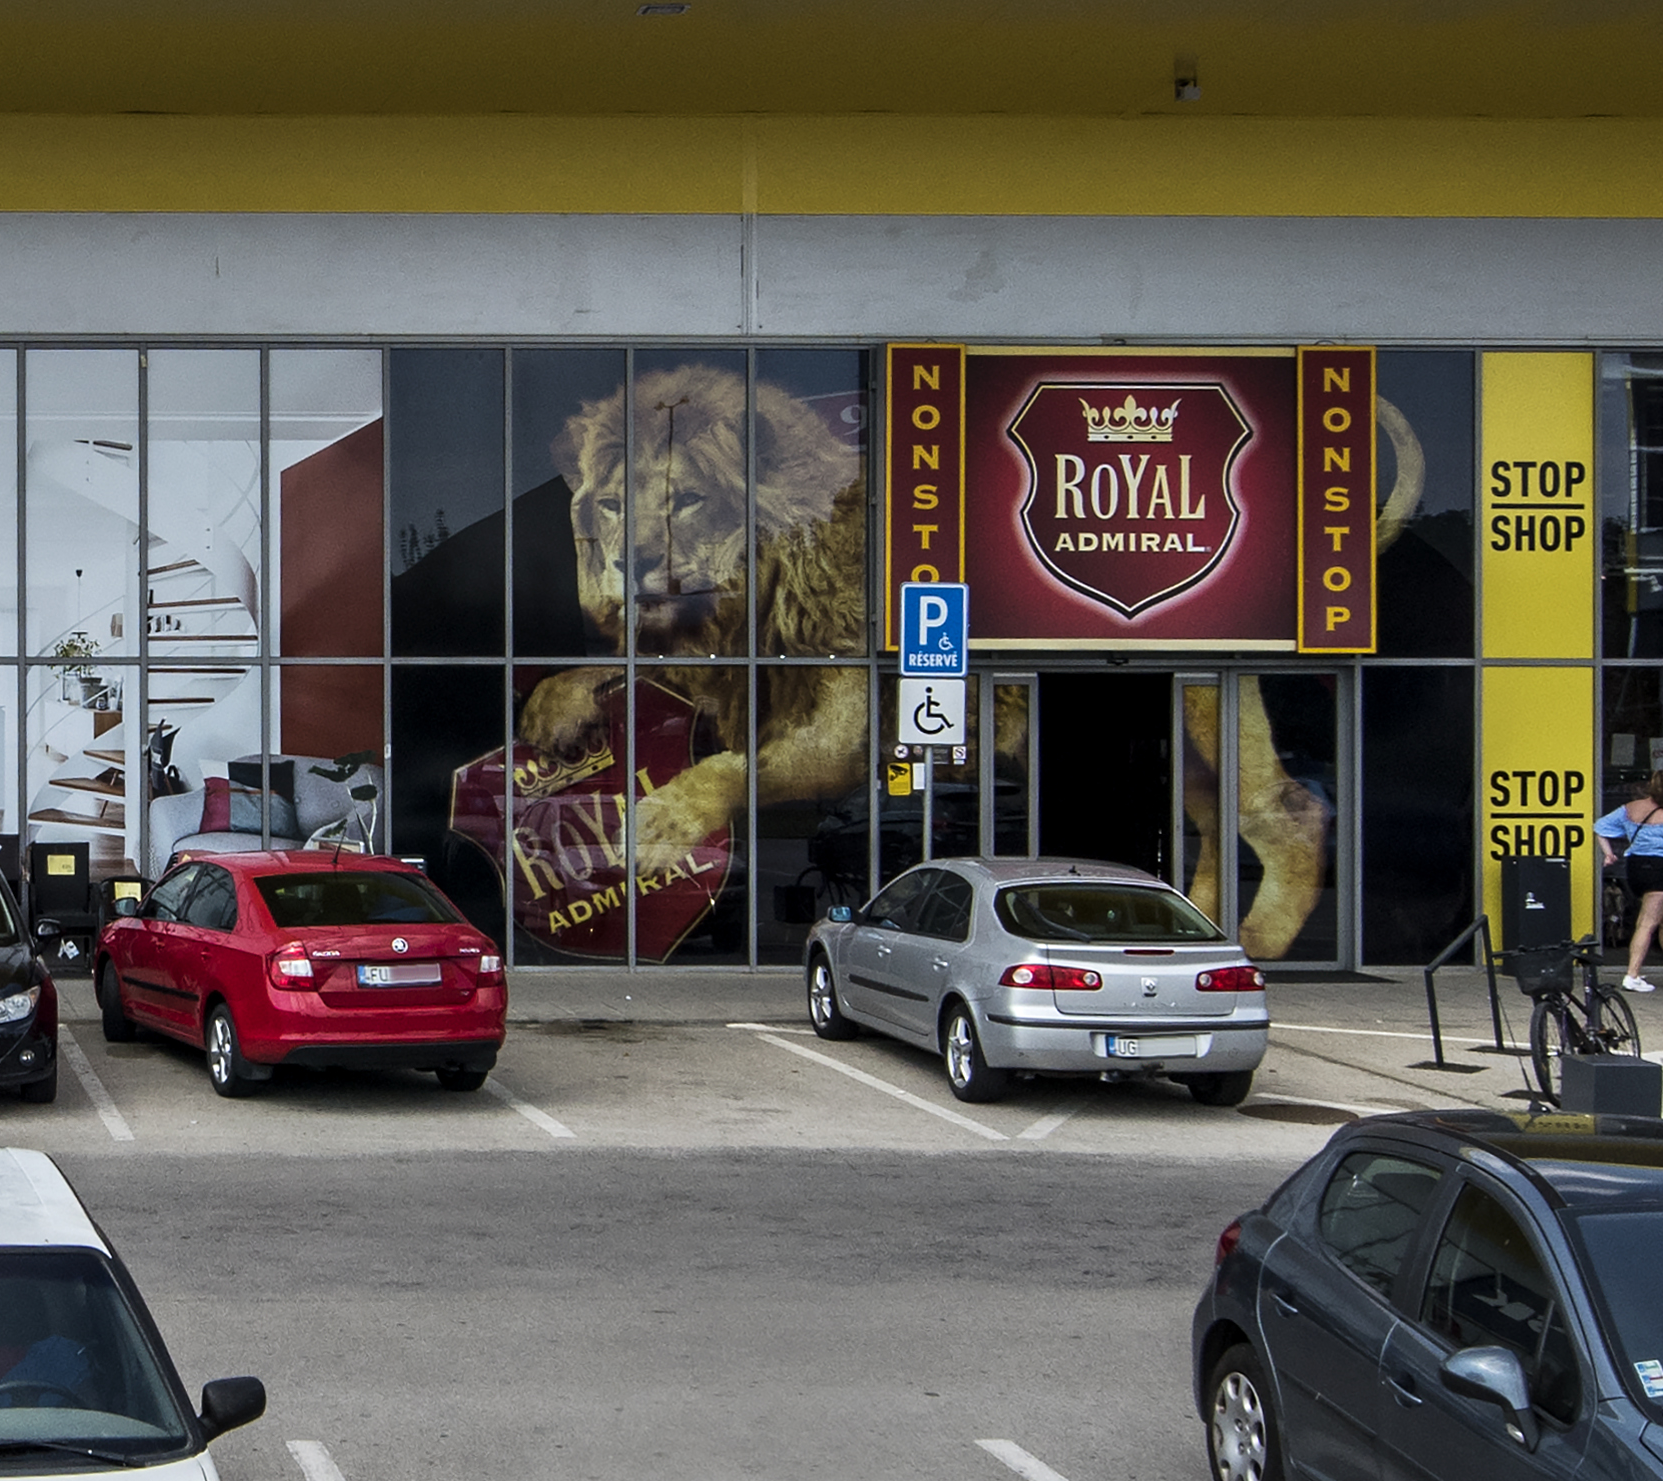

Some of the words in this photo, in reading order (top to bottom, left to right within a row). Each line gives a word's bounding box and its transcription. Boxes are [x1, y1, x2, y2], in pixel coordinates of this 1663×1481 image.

[911, 365, 941, 583] NONSTO
[1054, 453, 1206, 520] ROYAL
[1491, 460, 1586, 498] STOP
[1322, 367, 1352, 632] NONSTOP
[1054, 532, 1206, 553] ADMIRAL
[1491, 515, 1586, 552] SHOP
[919, 595, 949, 646] P
[908, 651, 958, 668] RÉSERVÉ
[1490, 770, 1585, 807] STOP
[1490, 825, 1585, 861] SHOP
